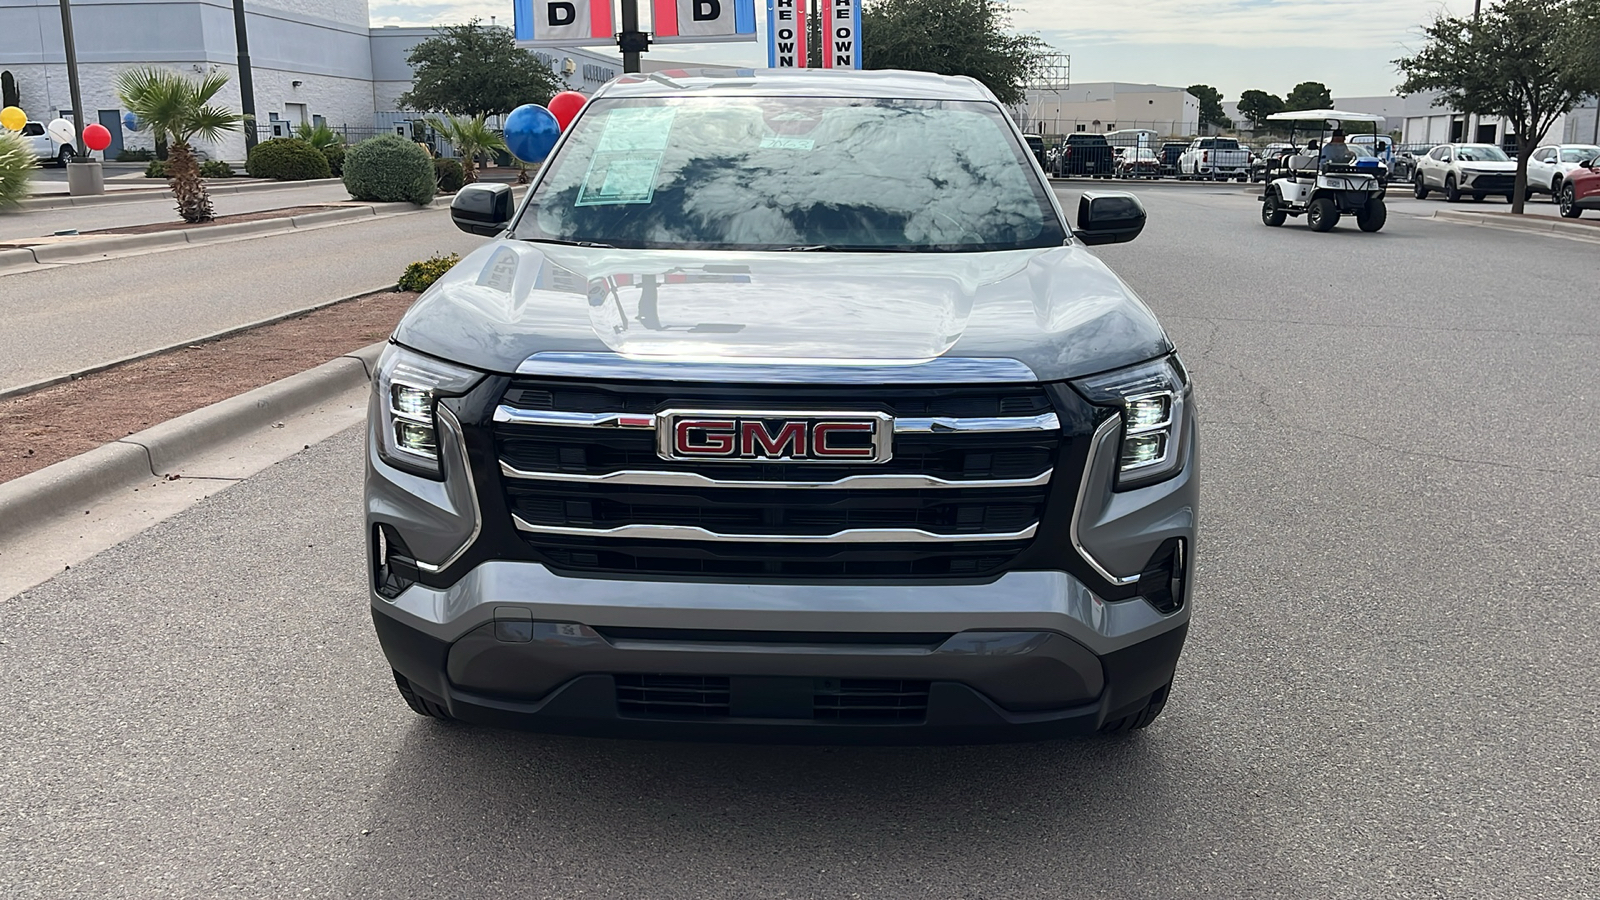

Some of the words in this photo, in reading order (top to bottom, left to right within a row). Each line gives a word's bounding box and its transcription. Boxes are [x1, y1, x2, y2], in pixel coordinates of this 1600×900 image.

[547, 2, 576, 26] D
[692, 0, 721, 21] D
[778, 28, 794, 67] OWN
[835, 27, 852, 66] OWN
[675, 419, 875, 457] GMC
